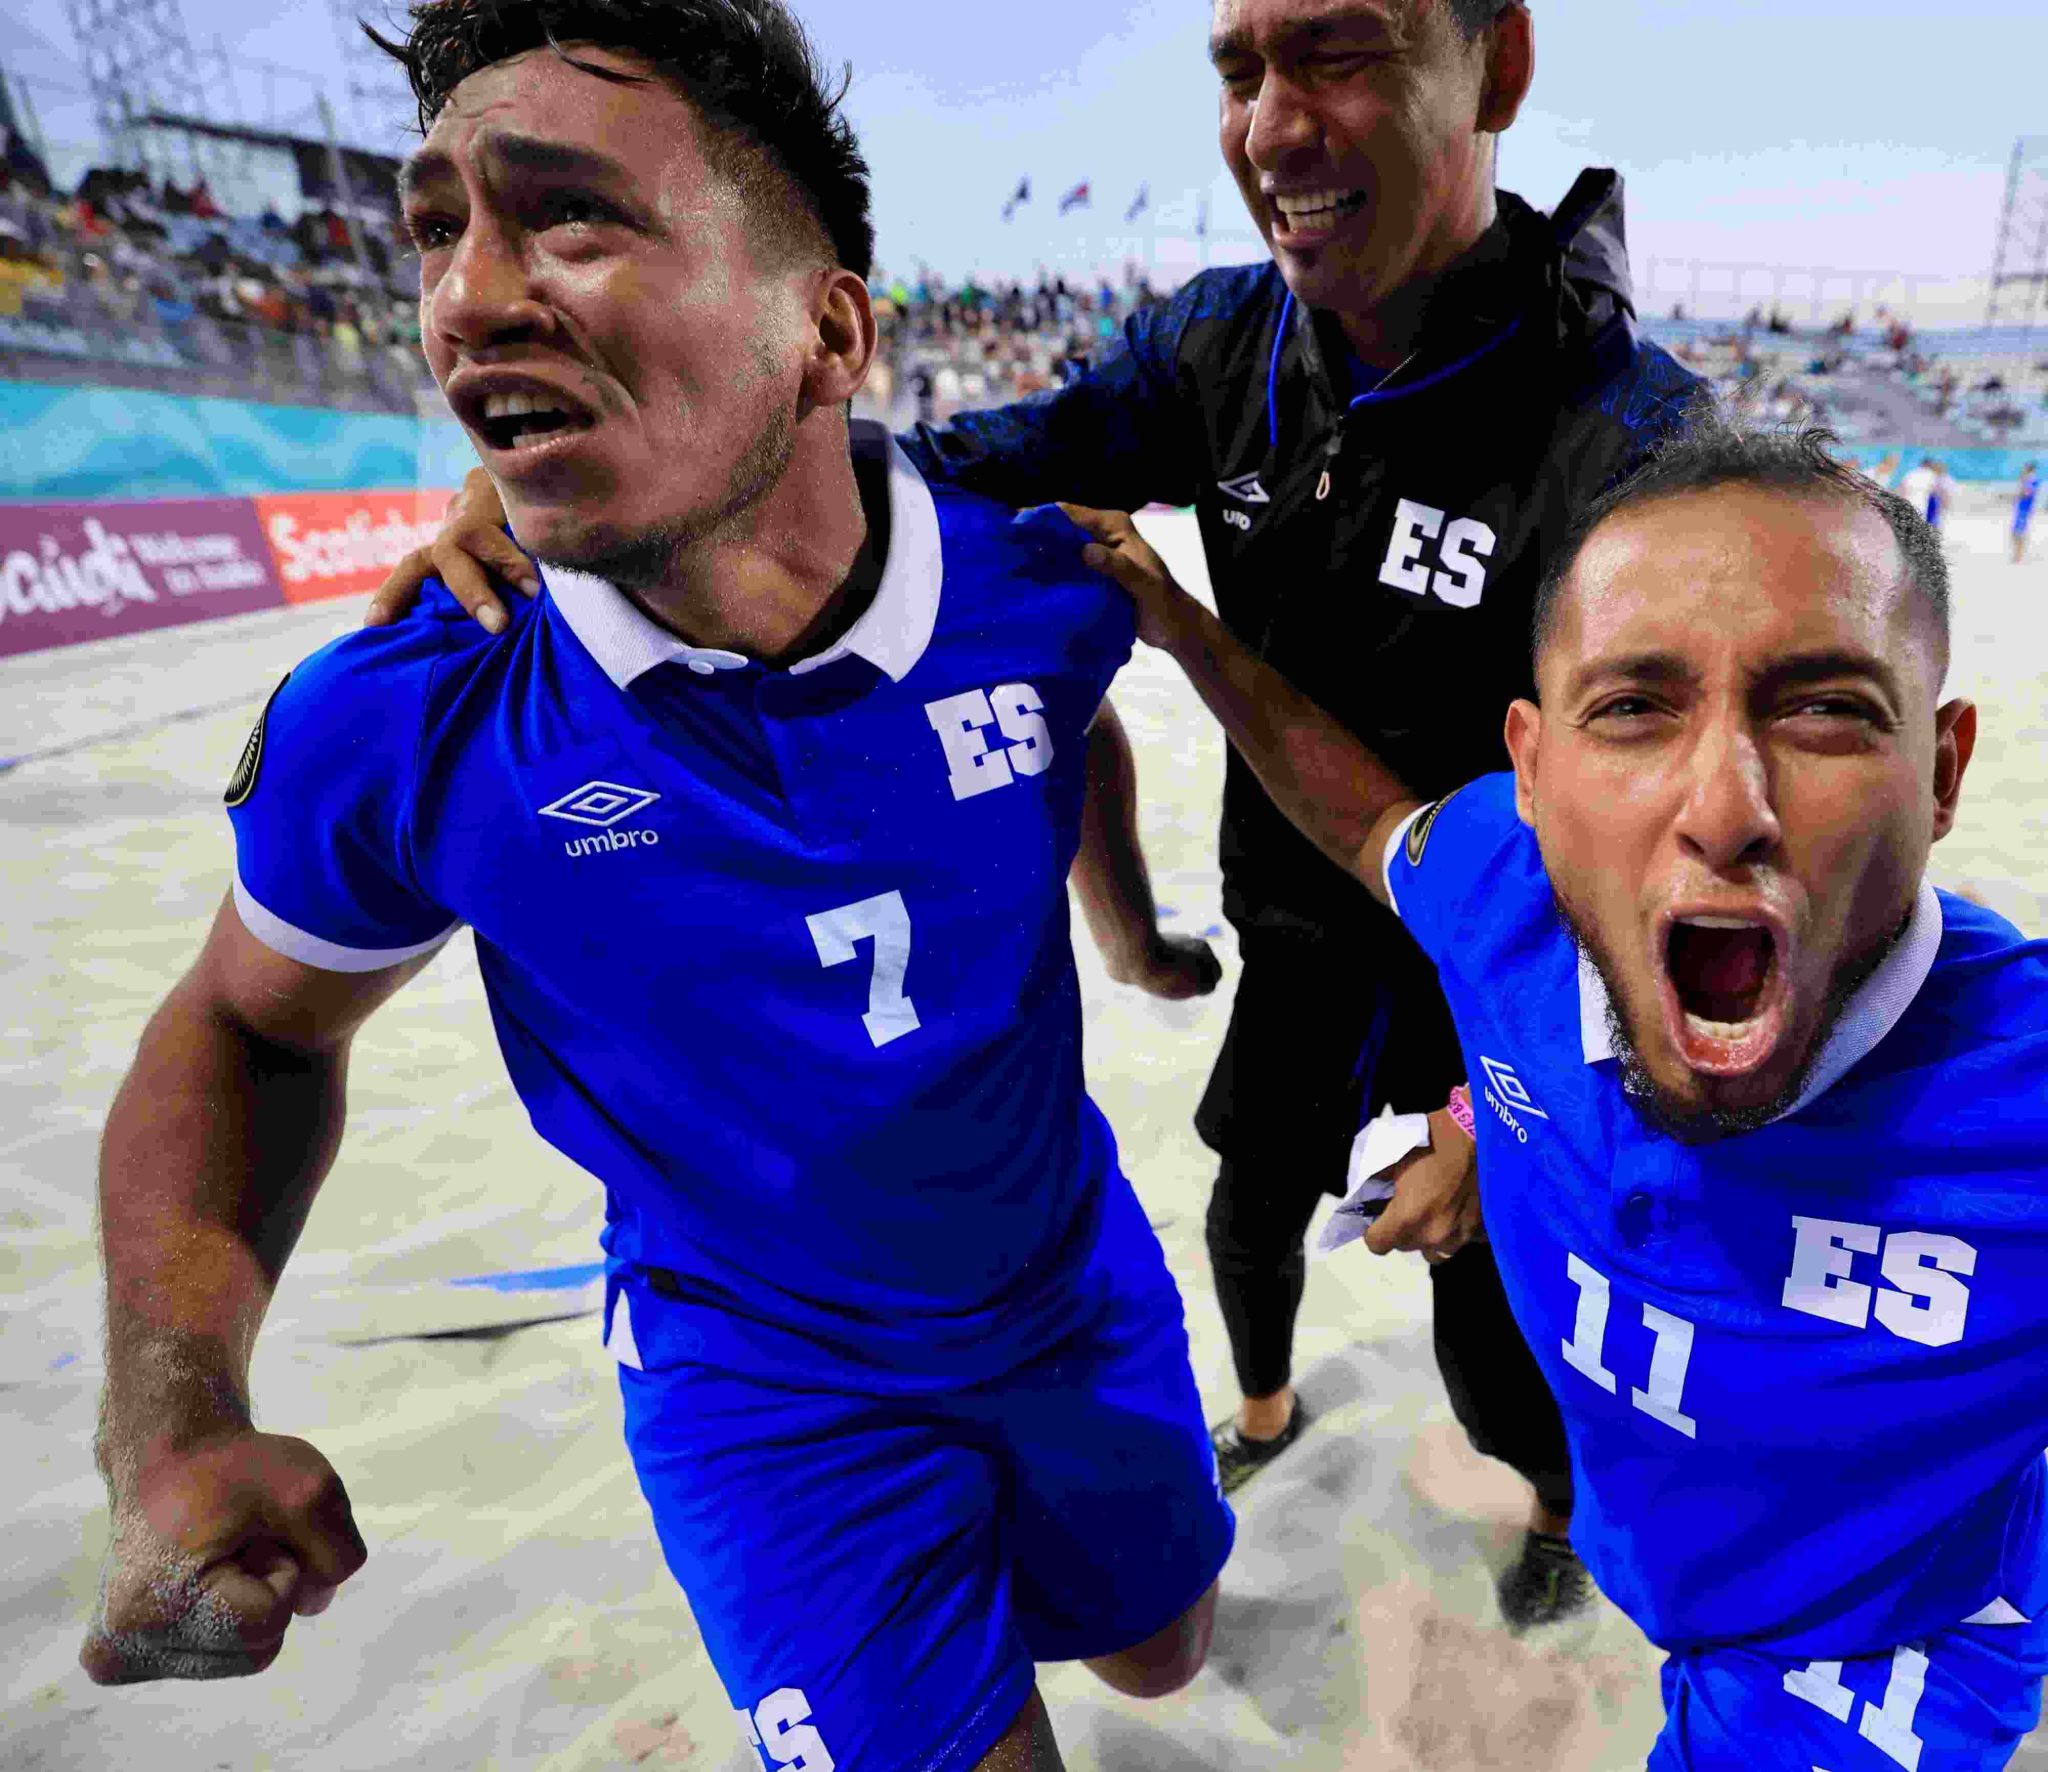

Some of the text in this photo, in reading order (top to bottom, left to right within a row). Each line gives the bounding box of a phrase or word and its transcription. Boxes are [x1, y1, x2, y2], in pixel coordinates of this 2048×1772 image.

[1379, 498, 1497, 609] ES
[924, 683, 1054, 801] ES
[565, 827, 659, 857] umbro
[805, 890, 921, 1048] 7
[1484, 1086, 1528, 1143] umbro
[1782, 1215, 1977, 1347] ES
[1562, 1252, 1696, 1439] 11
